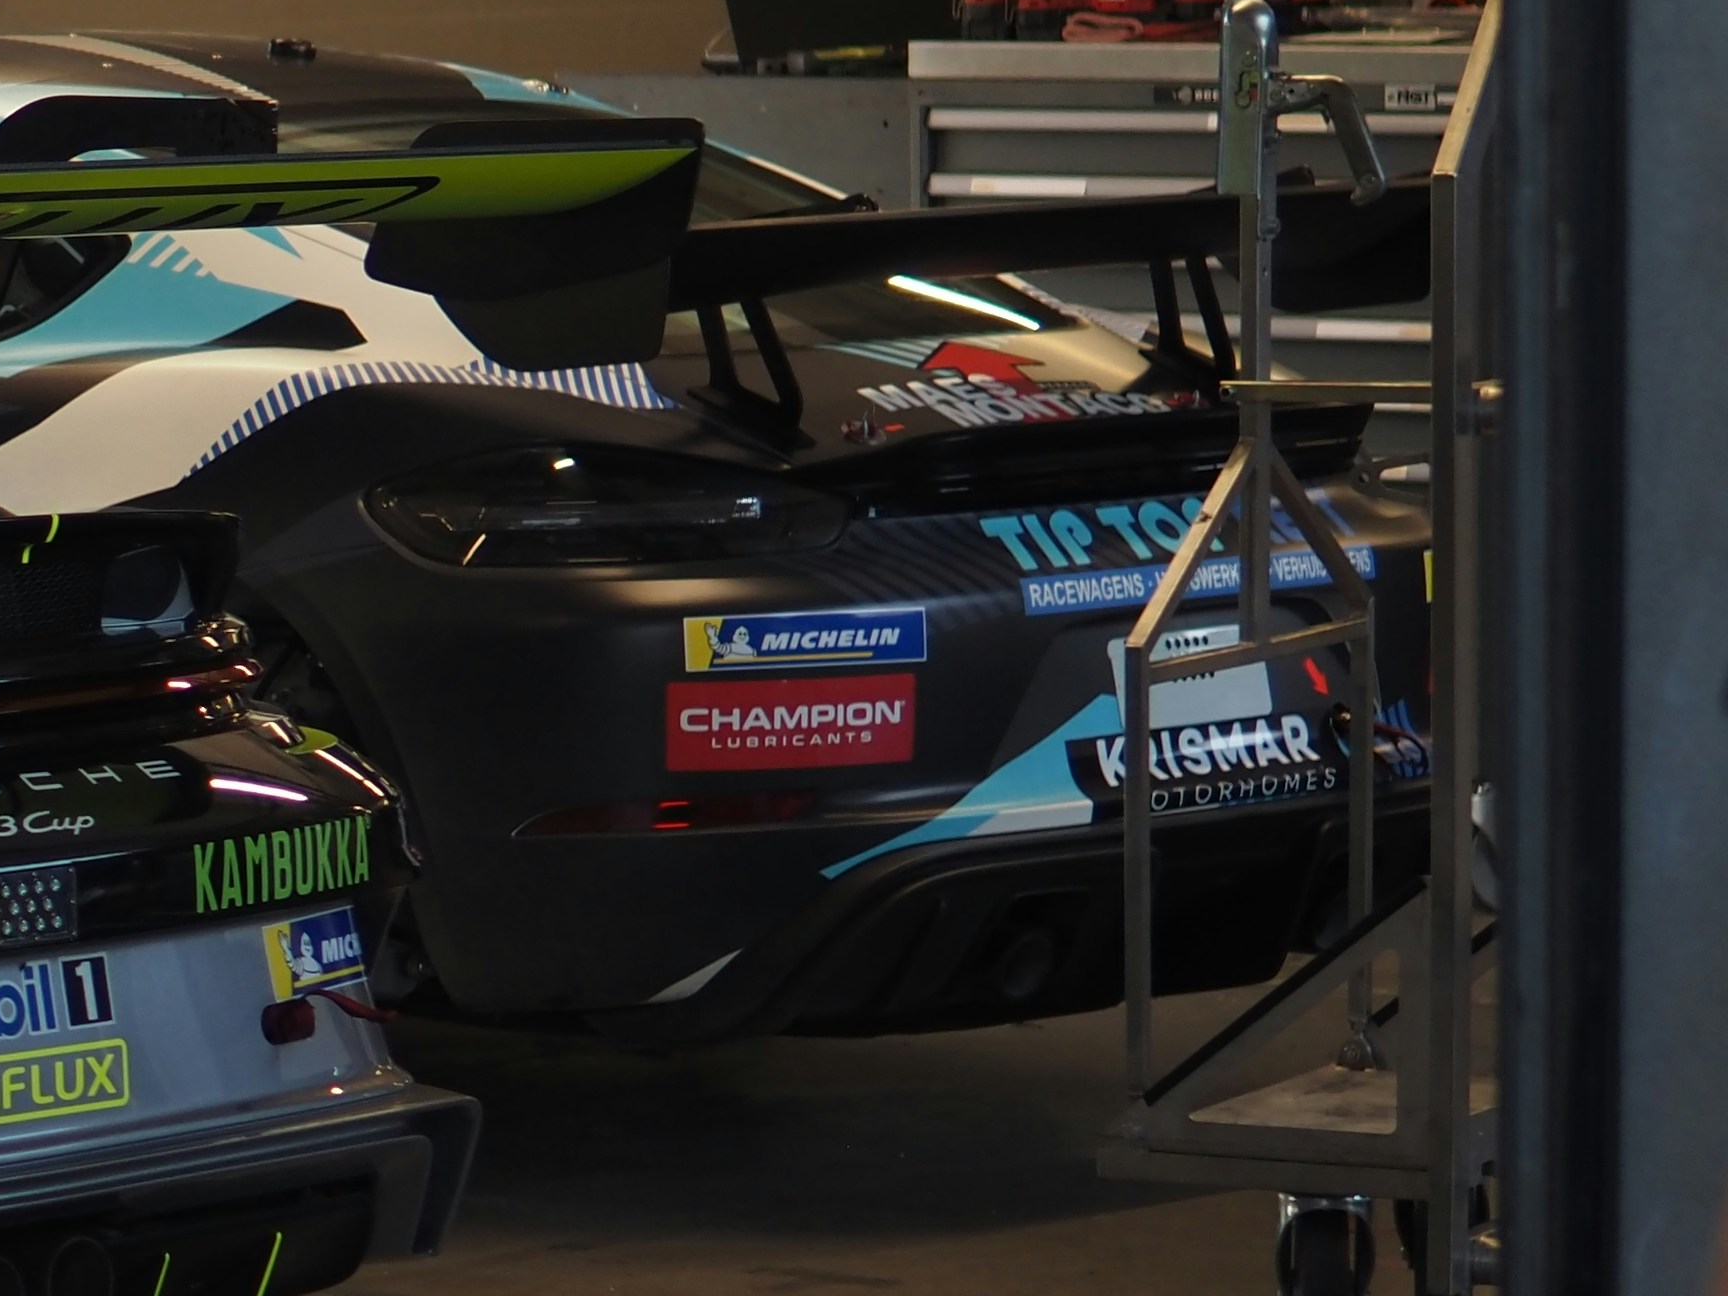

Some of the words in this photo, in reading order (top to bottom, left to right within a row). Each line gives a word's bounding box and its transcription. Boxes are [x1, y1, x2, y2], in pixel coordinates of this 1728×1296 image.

[858, 374, 1017, 412] MAES
[980, 508, 1093, 571] TIP
[1029, 572, 1144, 608] RACEWAGENS
[760, 627, 900, 652] MICHELIN
[680, 701, 901, 732] CHAMPION
[711, 730, 872, 748] LUBRICANTS
[1151, 767, 1338, 811] OTORHOMES
[23, 811, 95, 835] Cup
